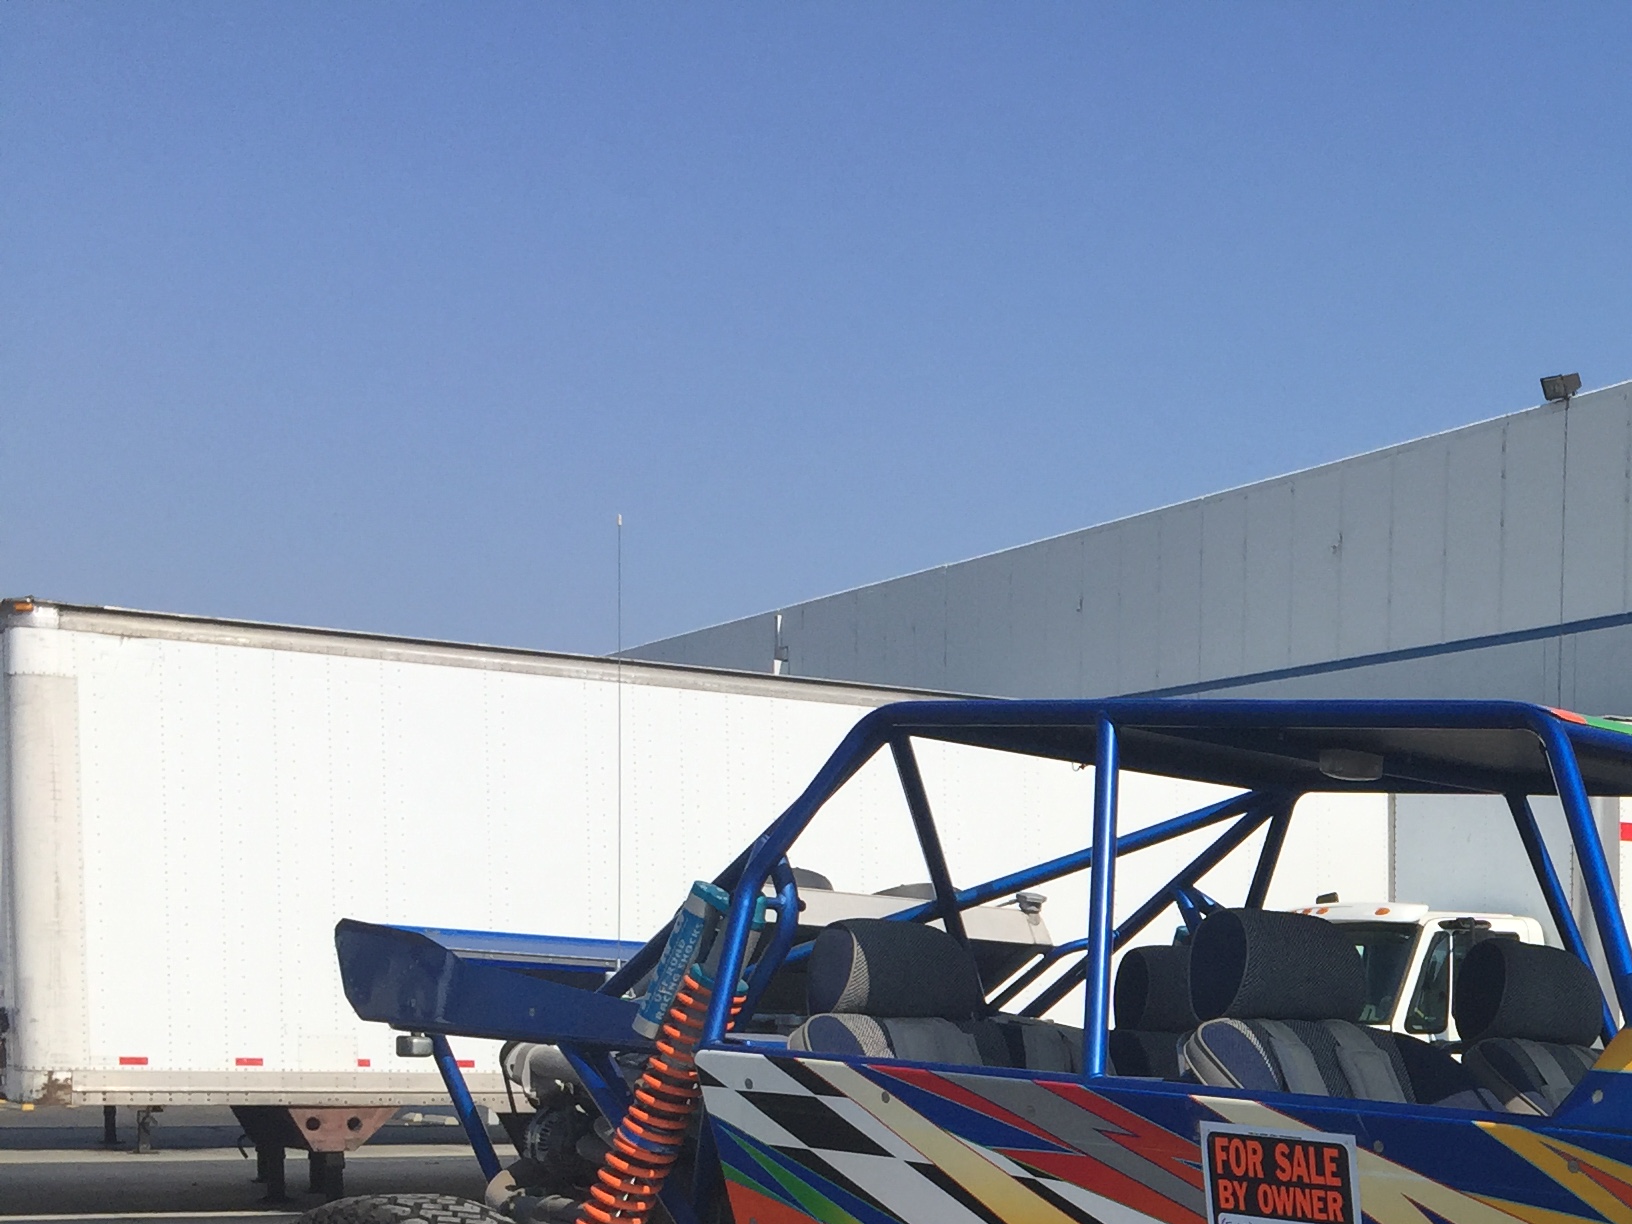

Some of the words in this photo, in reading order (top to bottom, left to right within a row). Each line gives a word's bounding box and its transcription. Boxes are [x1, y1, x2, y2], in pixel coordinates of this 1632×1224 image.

[1214, 1136, 1264, 1179] FOR
[1274, 1142, 1342, 1187] SALE
[1217, 1178, 1248, 1211] BY
[1256, 1182, 1345, 1222] OWNER
